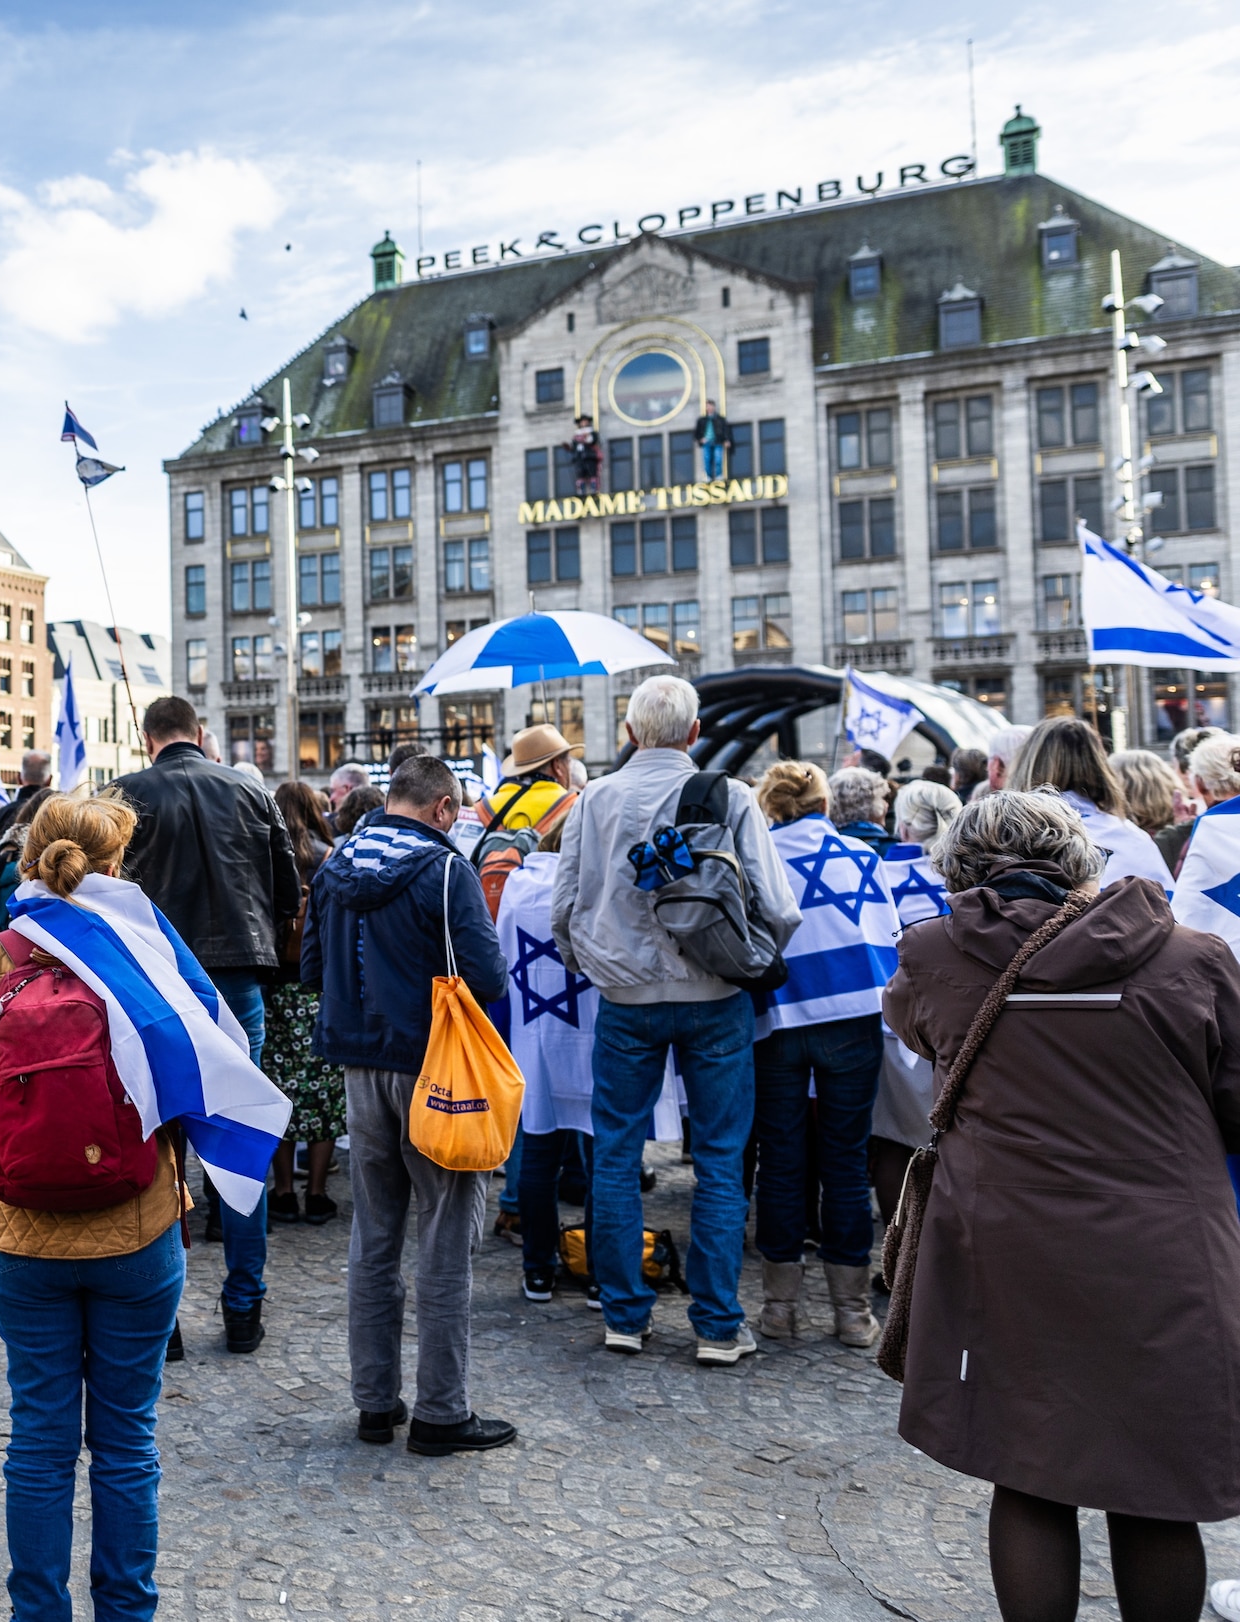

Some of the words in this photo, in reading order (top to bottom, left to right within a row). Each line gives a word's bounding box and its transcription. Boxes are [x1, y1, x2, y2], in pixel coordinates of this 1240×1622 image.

[416, 237, 523, 278] PEEK
[535, 230, 566, 250] &
[577, 155, 976, 245] CLOPPENBURG
[518, 489, 647, 525] MADAME
[650, 473, 789, 511] TUSSAUD
